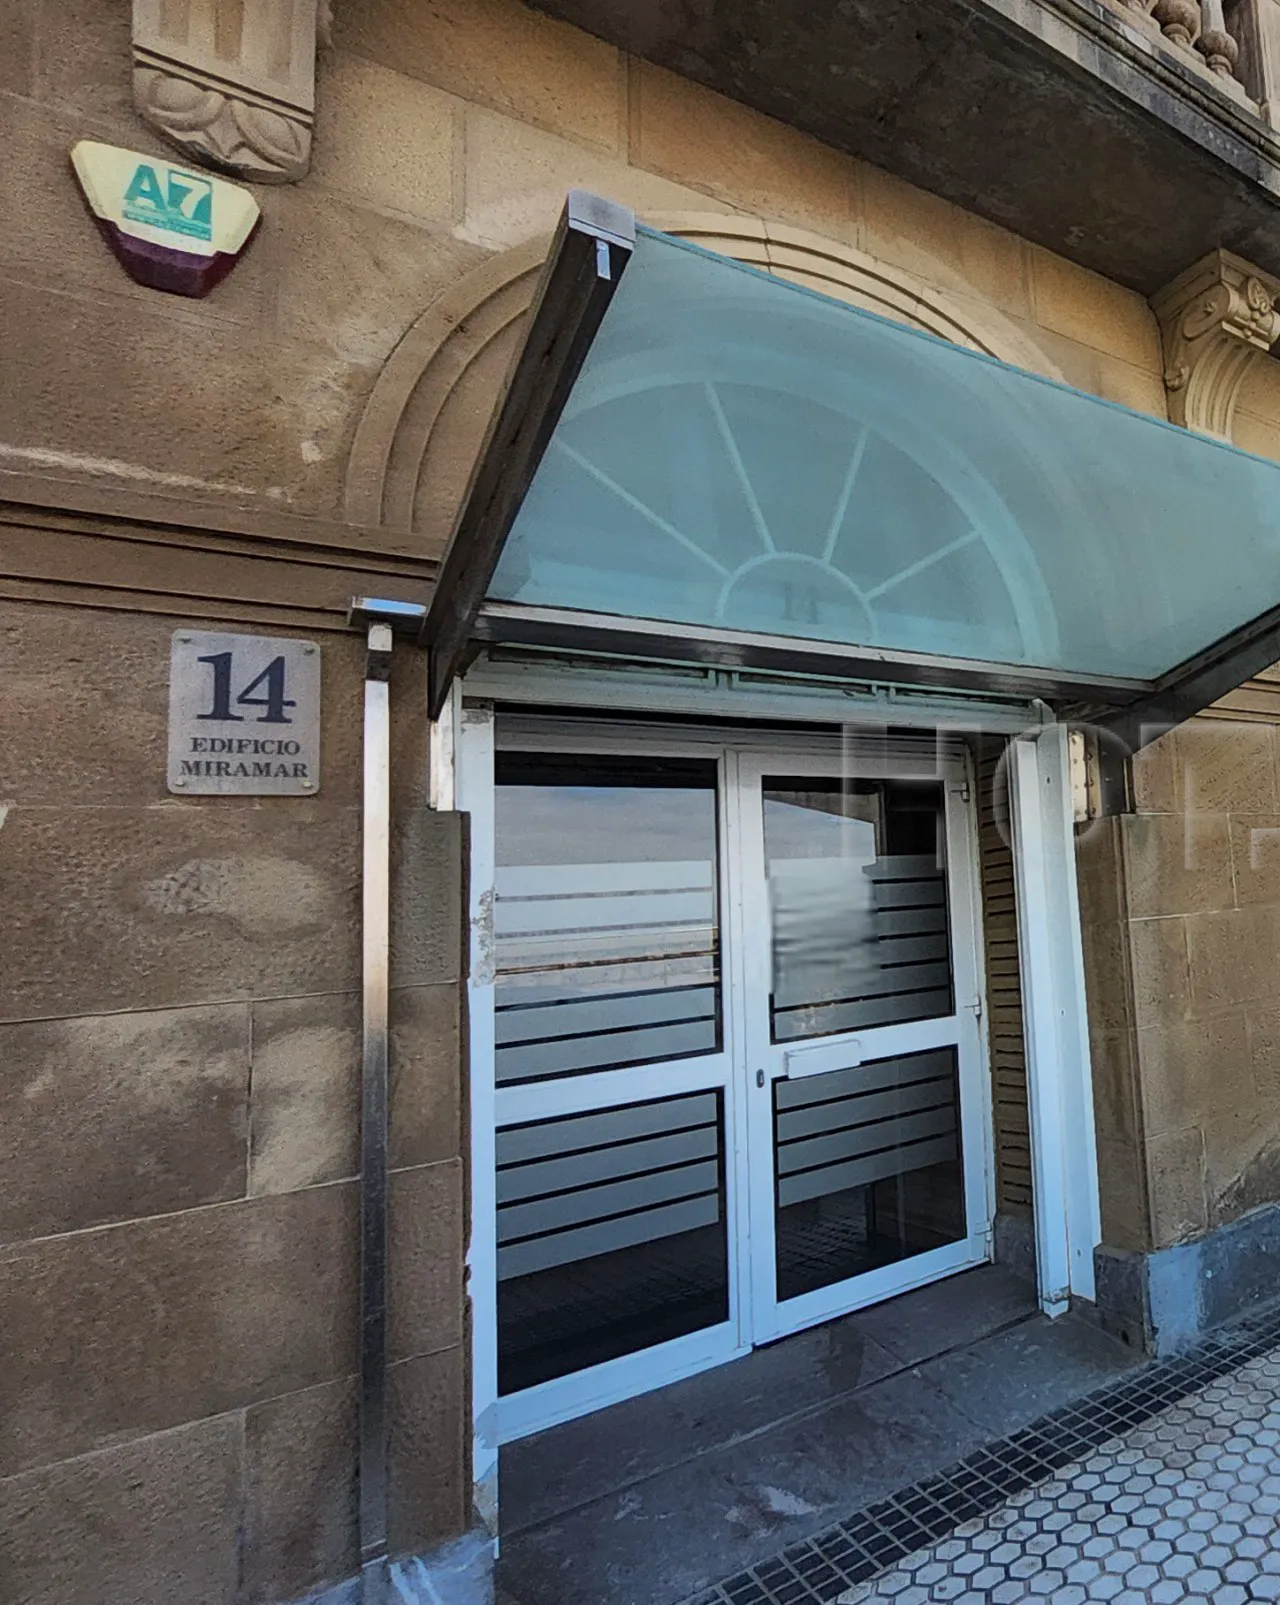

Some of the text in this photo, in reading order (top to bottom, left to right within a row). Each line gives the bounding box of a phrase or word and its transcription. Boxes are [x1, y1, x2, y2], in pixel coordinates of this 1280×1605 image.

[123, 164, 213, 224] A7
[196, 651, 297, 724] 14
[189, 737, 301, 756] EDIFICIO
[180, 760, 309, 778] MIRAMAR
